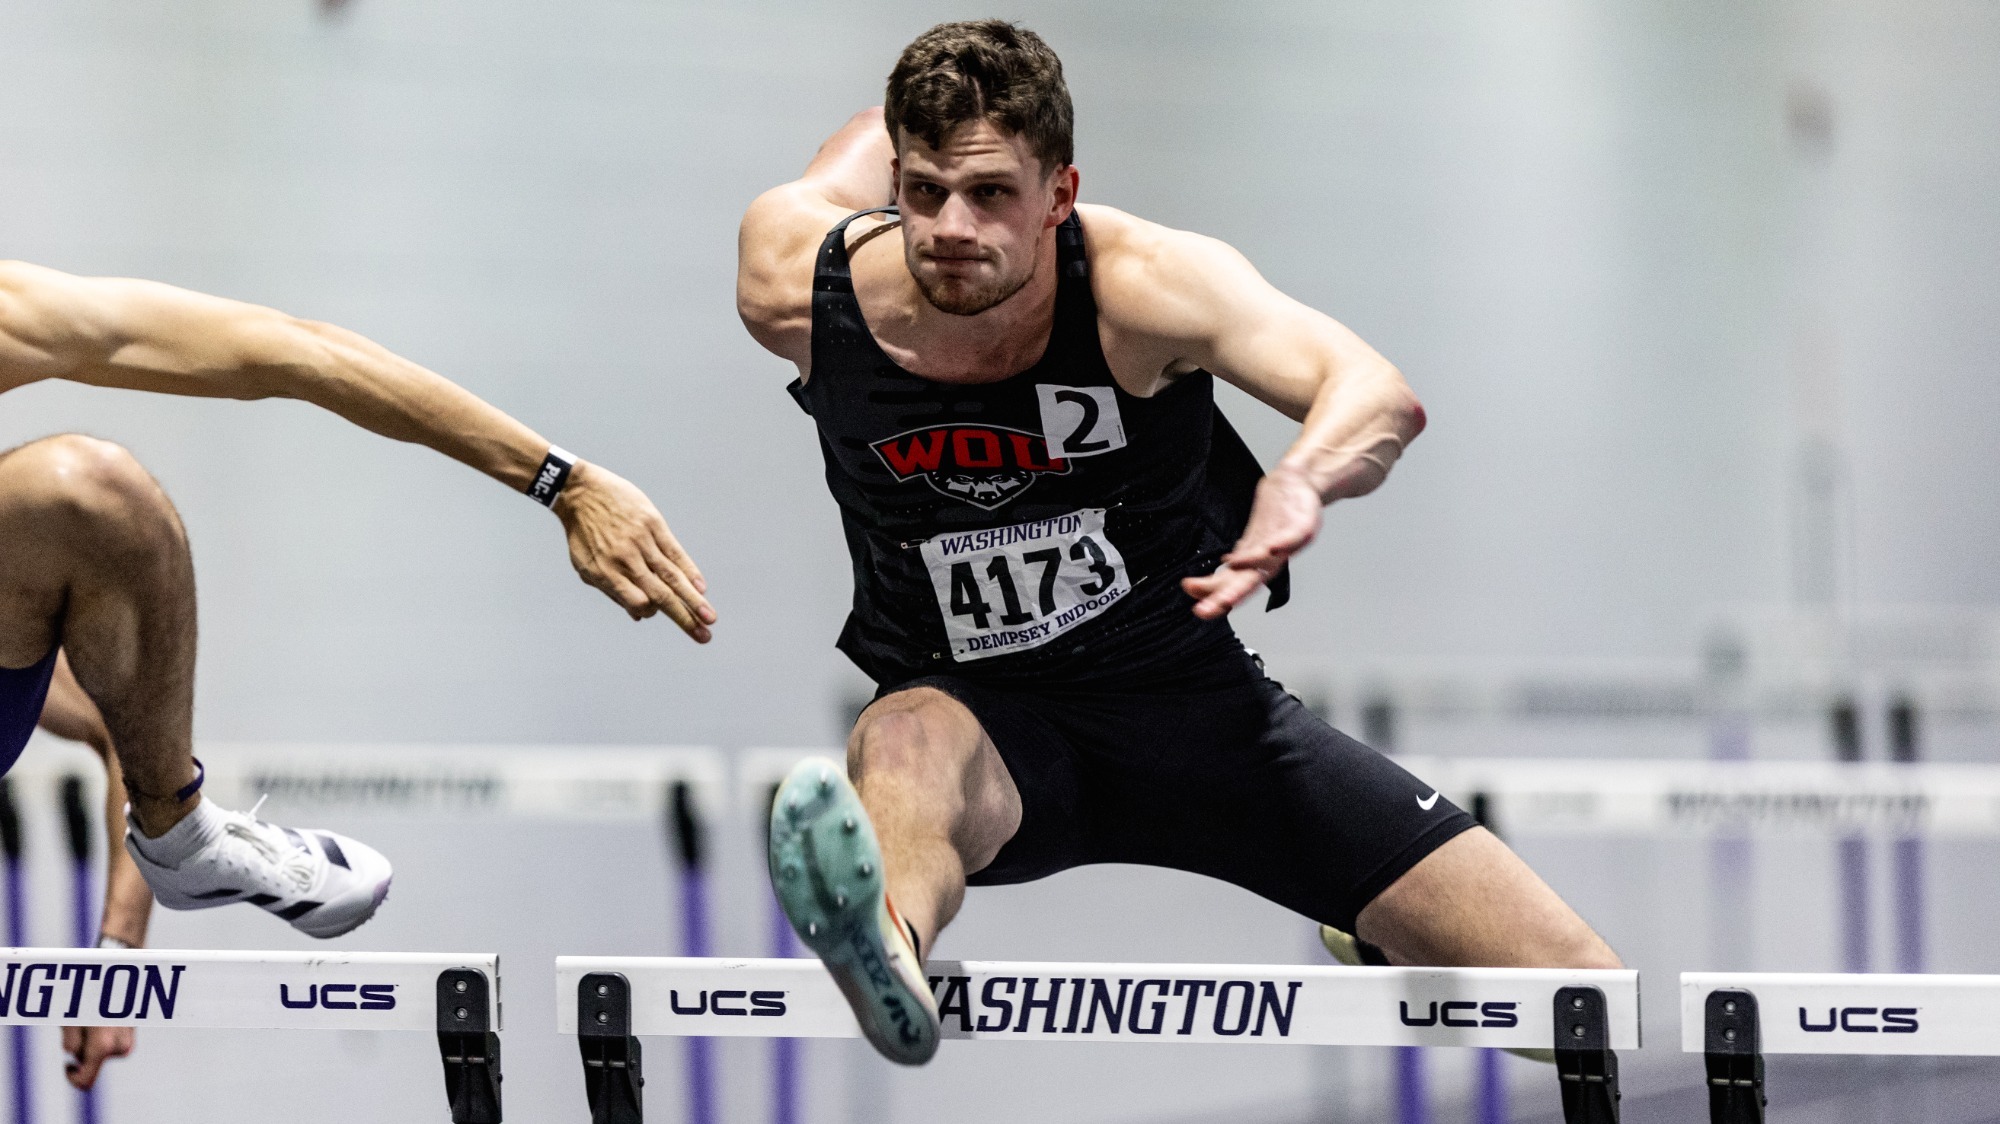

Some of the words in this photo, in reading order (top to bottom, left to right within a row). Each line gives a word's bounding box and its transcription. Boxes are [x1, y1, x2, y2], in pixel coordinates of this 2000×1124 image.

[1054, 390, 1111, 454] 2
[880, 429, 1065, 475] WOU
[940, 514, 1082, 556] WASHINGTON
[950, 535, 1116, 630] 4173
[966, 621, 1051, 652] DEMPSEY
[1056, 587, 1120, 628] INDOOR
[279, 983, 396, 1010] UCS
[670, 989, 787, 1017] UCS
[1399, 1001, 1518, 1028] UCS
[1798, 1006, 1919, 1034] UCS
